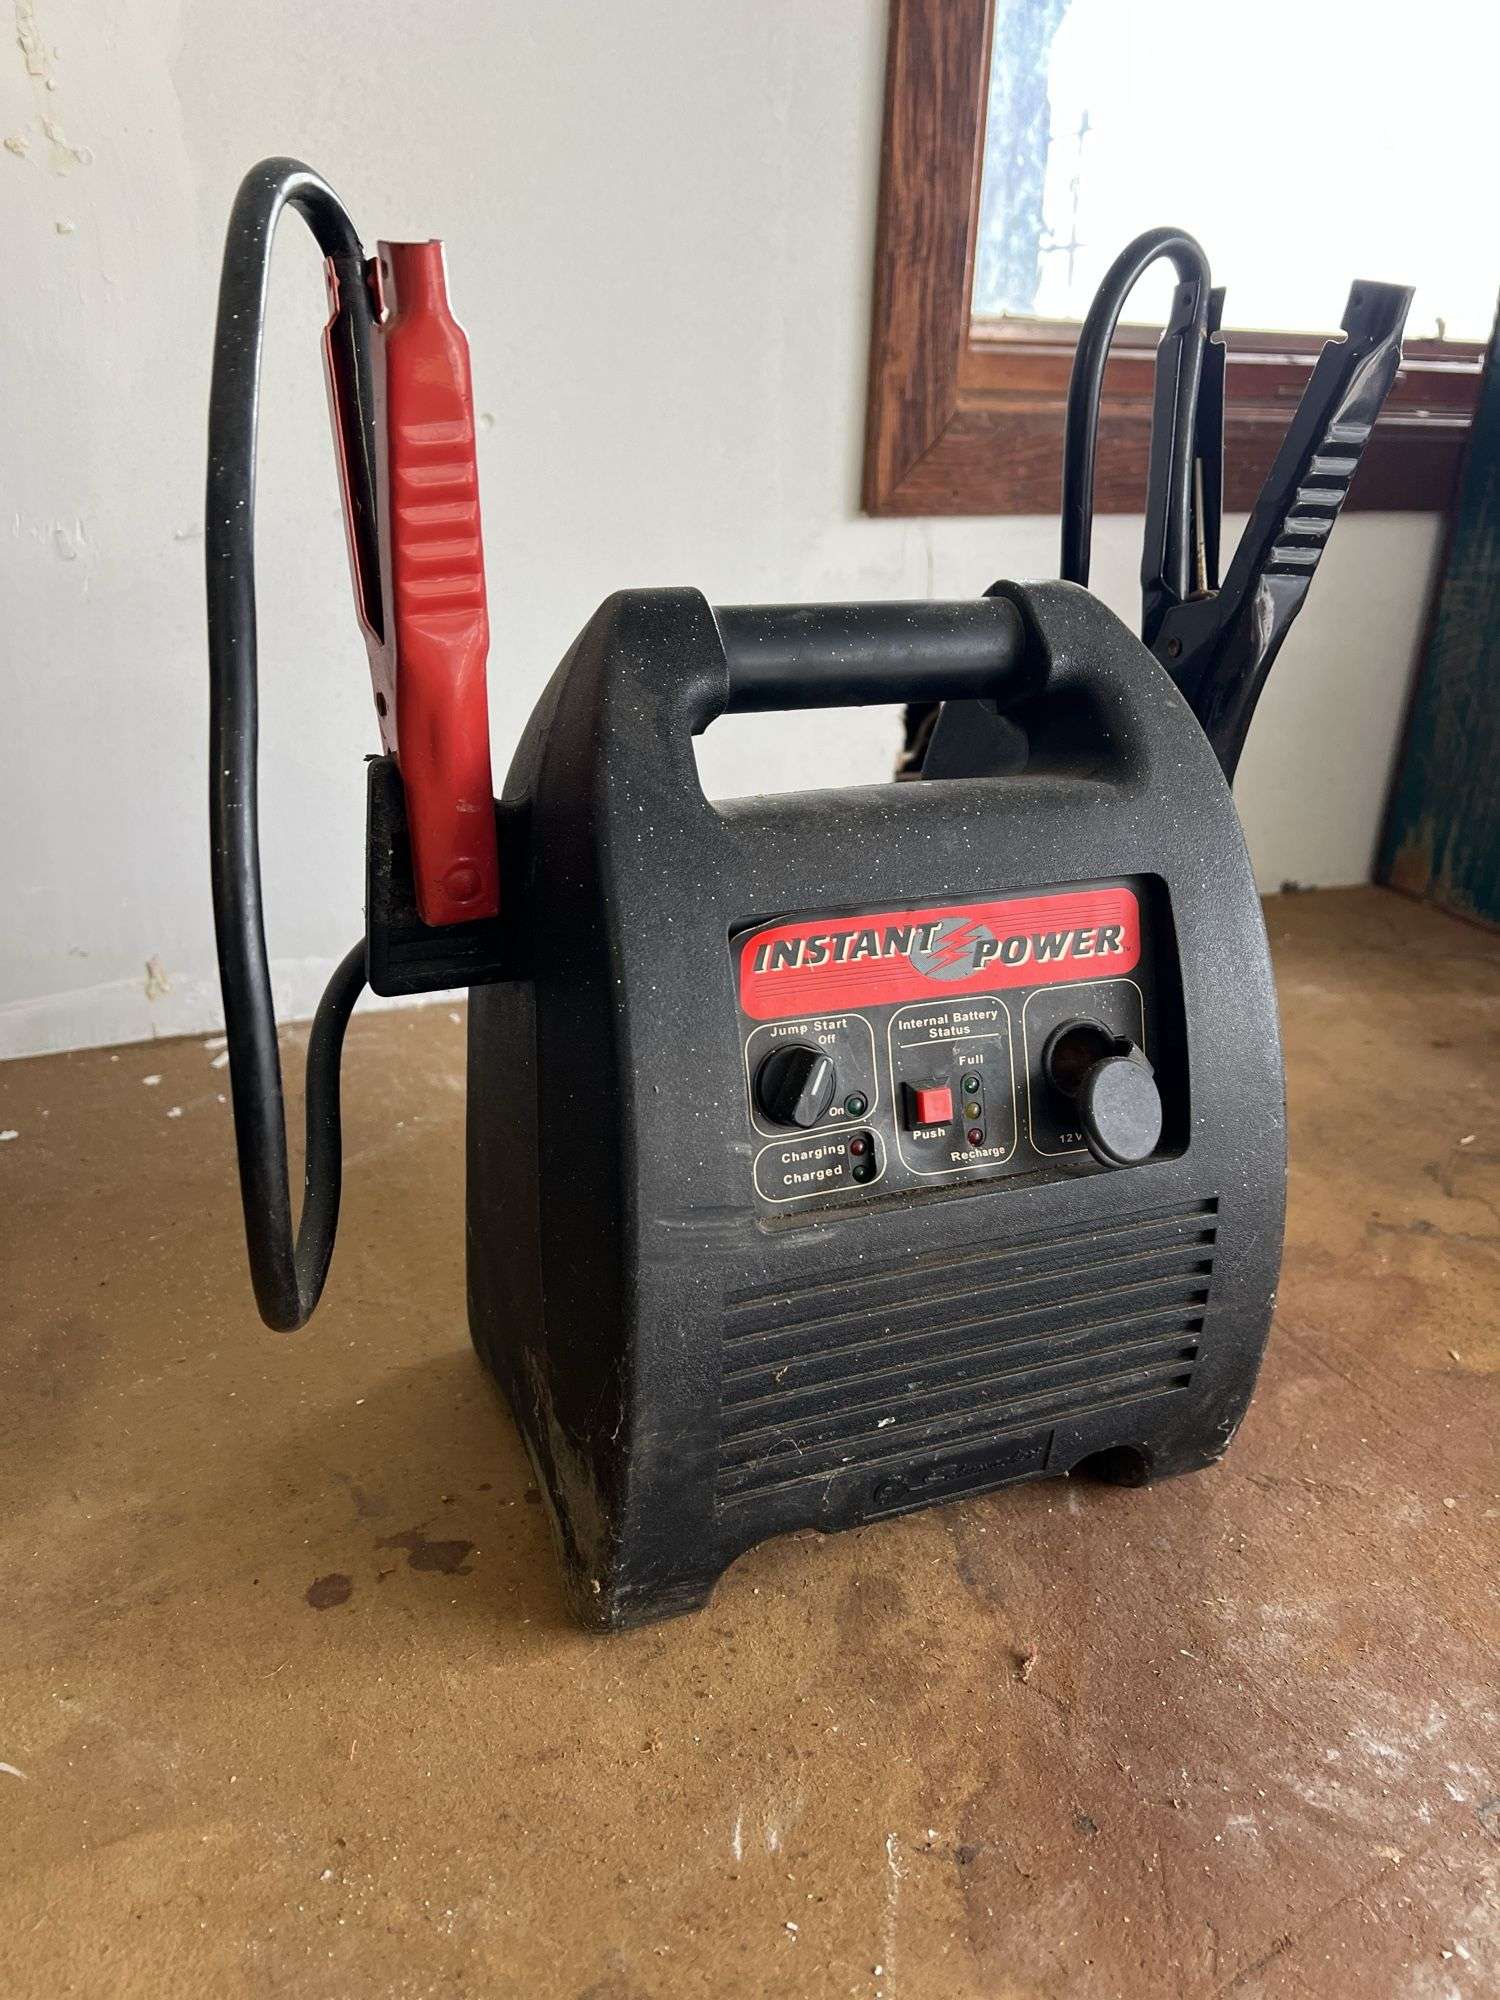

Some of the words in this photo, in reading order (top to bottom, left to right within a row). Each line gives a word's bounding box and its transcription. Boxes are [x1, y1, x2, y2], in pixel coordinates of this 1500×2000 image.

[753, 921, 943, 973] INSTANT
[971, 924, 1125, 969] POWER
[898, 1014, 949, 1030] Internal
[953, 1009, 998, 1023] Battery
[770, 1023, 808, 1038] Jump
[813, 1018, 848, 1031] Start
[929, 1025, 971, 1039] Status
[818, 1034, 836, 1045] Off
[958, 1054, 984, 1066] Full
[828, 1106, 845, 1117] On
[912, 1128, 946, 1140] Push
[781, 1144, 846, 1164] Charging
[950, 1146, 1005, 1162] Recharge
[783, 1165, 843, 1185] Charged
